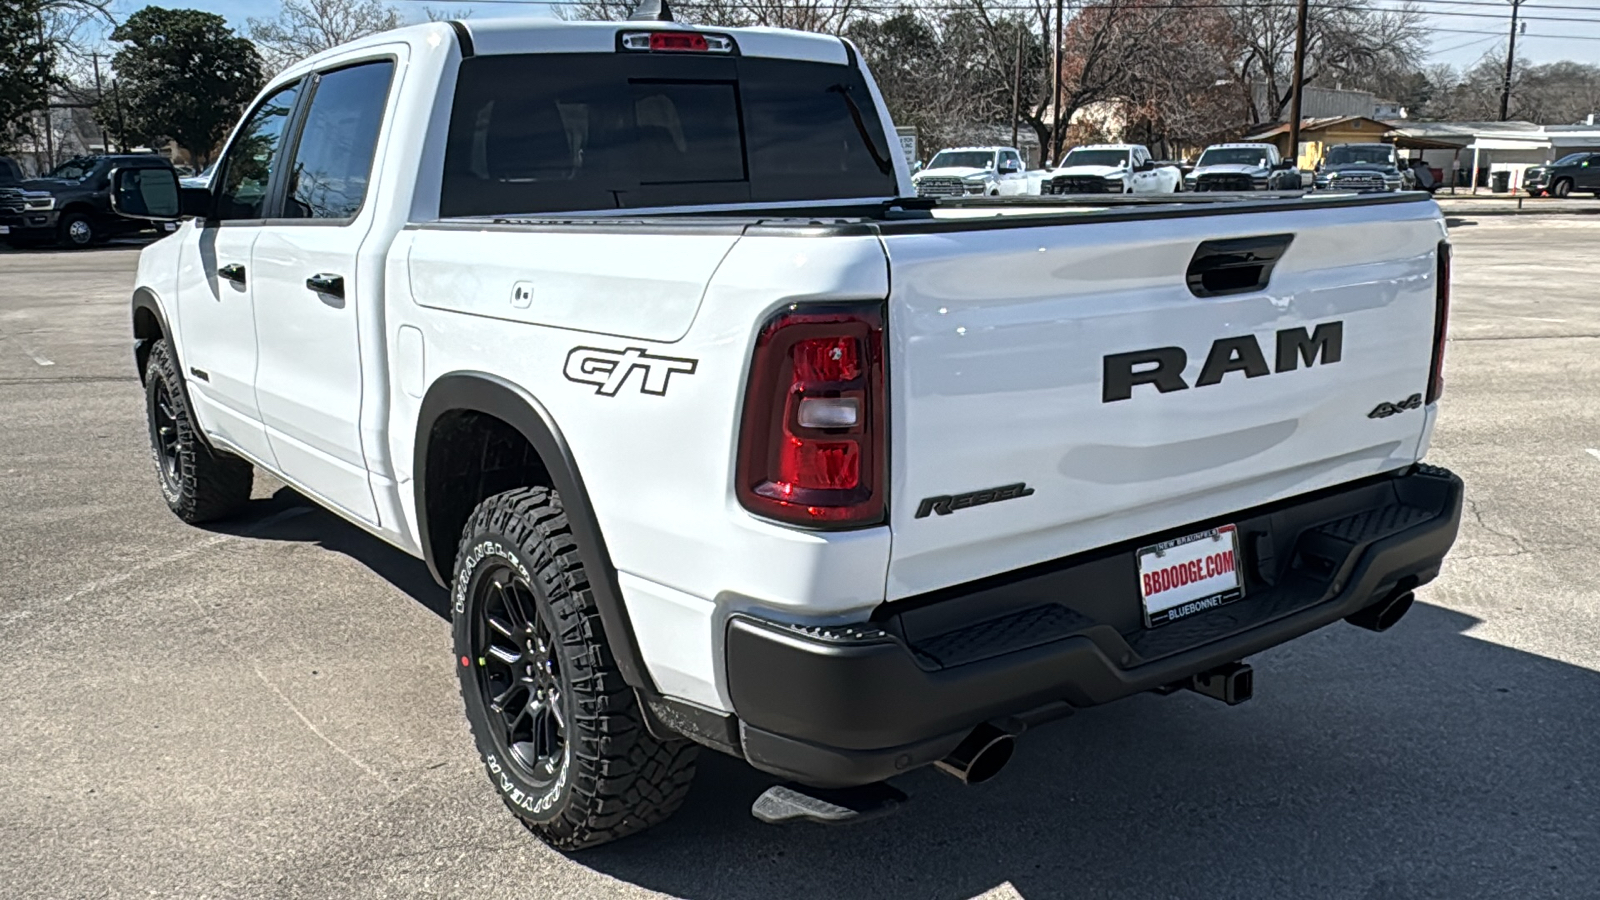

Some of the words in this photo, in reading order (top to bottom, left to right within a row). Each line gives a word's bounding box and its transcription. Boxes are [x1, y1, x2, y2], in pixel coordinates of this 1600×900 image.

[1102, 320, 1343, 403] RAM
[1159, 541, 1175, 550] NEW
[455, 541, 531, 614] WRANGLER
[1143, 550, 1235, 597] BBDODGE.COM
[1168, 595, 1222, 620] BLUEBONNET
